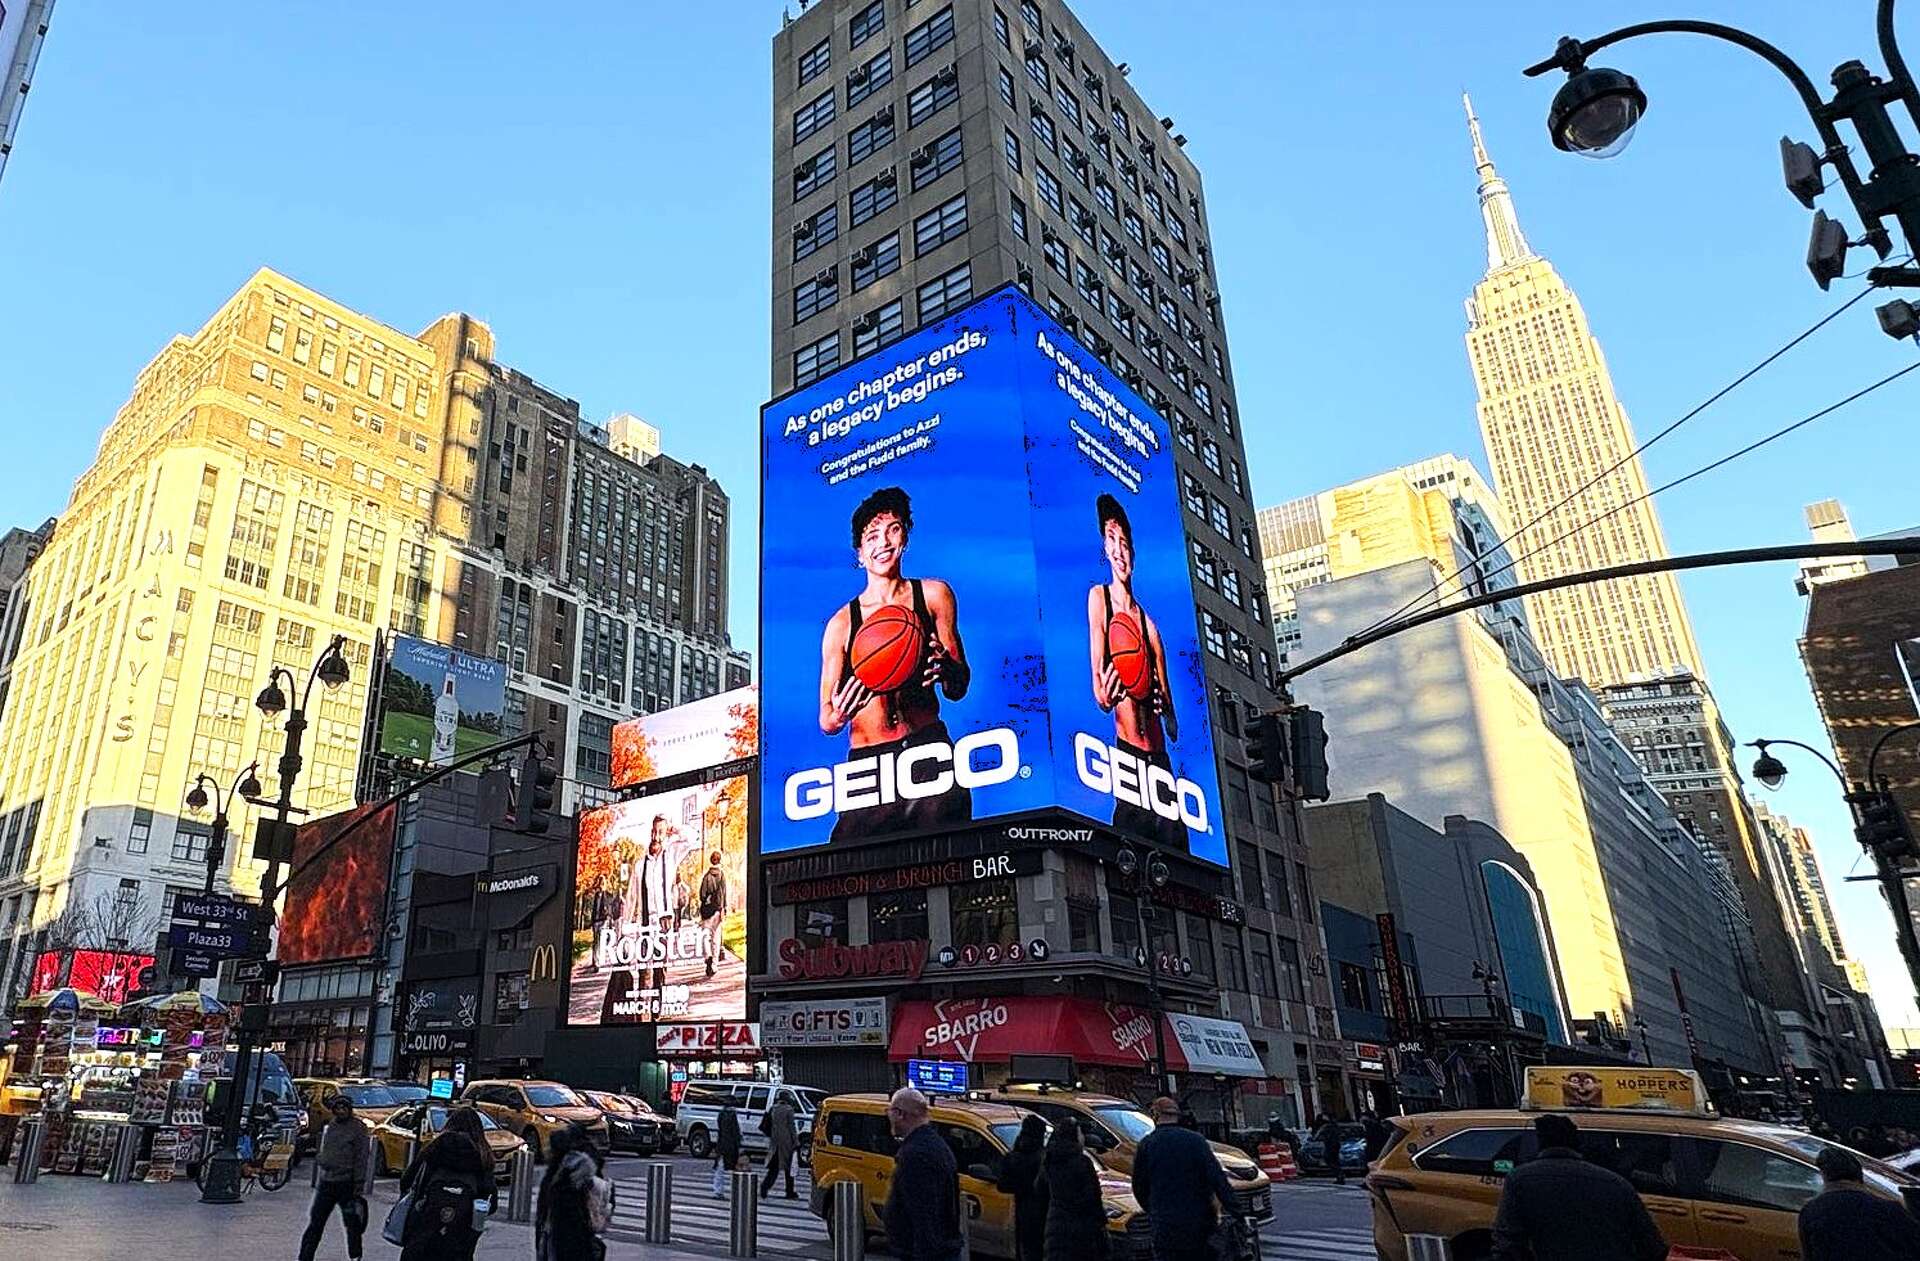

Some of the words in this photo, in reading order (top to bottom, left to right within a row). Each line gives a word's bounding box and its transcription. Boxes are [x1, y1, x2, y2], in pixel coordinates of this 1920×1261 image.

[784, 415, 807, 436] As
[809, 396, 844, 423] one
[847, 357, 925, 405] chapter
[928, 331, 987, 366] ends,
[1038, 332, 1055, 358] As
[1056, 351, 1081, 379] one
[1082, 373, 1128, 419] chapter
[808, 430, 820, 446] a
[821, 400, 883, 440] legacy
[887, 366, 963, 411] begins.
[1057, 373, 1066, 389] a
[1067, 375, 1107, 426] legacy
[1108, 410, 1149, 459] begins.
[821, 434, 901, 474] Congratulations
[903, 423, 916, 439] to
[829, 466, 849, 485] and
[850, 461, 867, 477] the
[869, 446, 895, 468] Fudd
[896, 435, 931, 458] family.
[458, 656, 495, 675] ULTRA
[784, 728, 1020, 821] GEICO
[1075, 732, 1208, 833] GEICO
[489, 875, 540, 893] McDonald's
[876, 877, 887, 890] &
[973, 855, 1016, 879] BAR
[181, 901, 211, 916] West
[236, 908, 248, 921] St
[188, 932, 232, 948] Plaza33
[596, 925, 712, 966] Rooster
[966, 949, 972, 962] 1
[987, 947, 997, 960] 2
[1011, 945, 1019, 959] 3
[779, 938, 930, 981] Subway
[613, 1001, 650, 1015] MARCH
[415, 1035, 447, 1050] OLIYO
[682, 1024, 754, 1046] PIZZA
[925, 1005, 1008, 1048] SBARRO
[1112, 1015, 1152, 1050] SBARRO
[1400, 1042, 1422, 1052] BAR
[1616, 1079, 1689, 1091] HOPPERS
